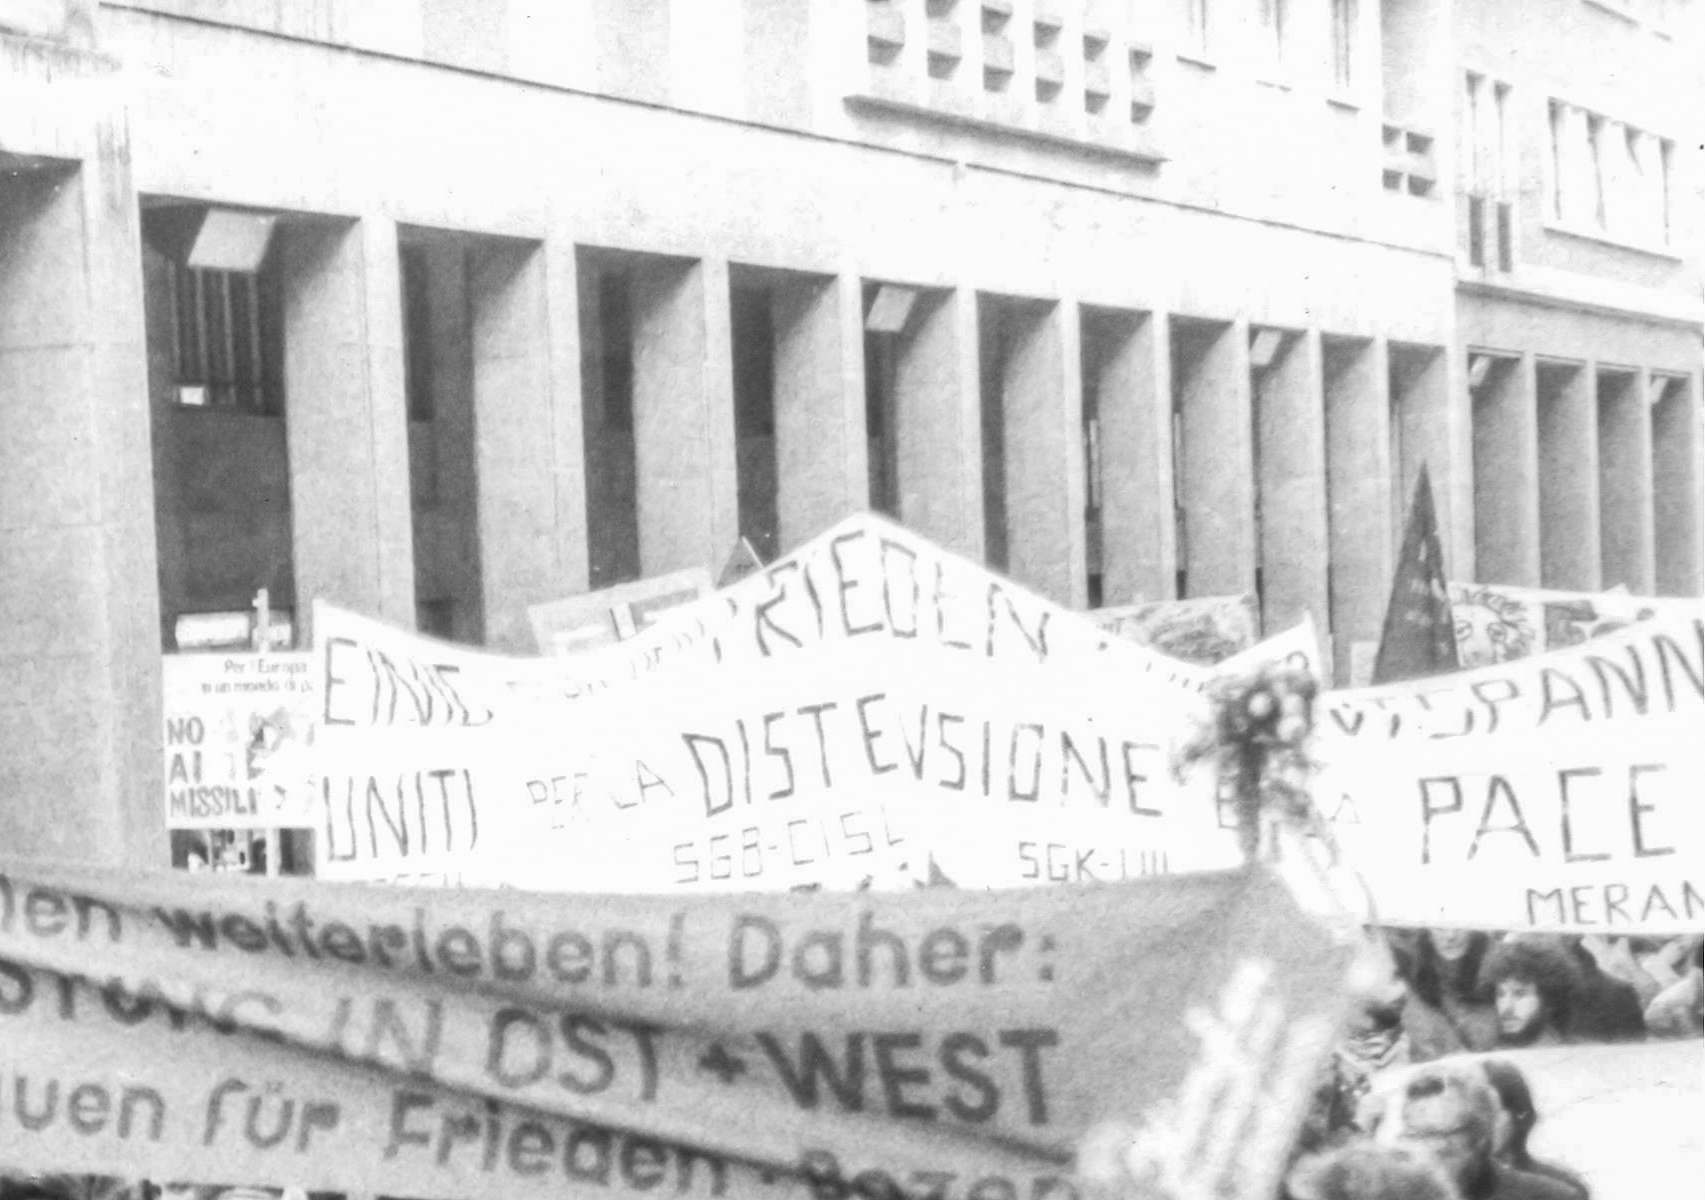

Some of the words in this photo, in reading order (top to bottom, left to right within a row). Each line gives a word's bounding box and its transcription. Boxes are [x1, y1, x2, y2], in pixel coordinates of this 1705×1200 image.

[166, 715, 206, 746] NO
[169, 749, 202, 785] AI
[169, 784, 259, 818] MISSILI
[322, 767, 480, 863] UNITI
[1417, 763, 1678, 866] PACE
[154, 898, 687, 988] weiterleben!
[728, 909, 1058, 991] Daher:
[487, 1006, 668, 1102] OST
[754, 1026, 1059, 1126] WEST
[202, 1076, 341, 1153] für
[381, 1092, 728, 1197] Frieden
